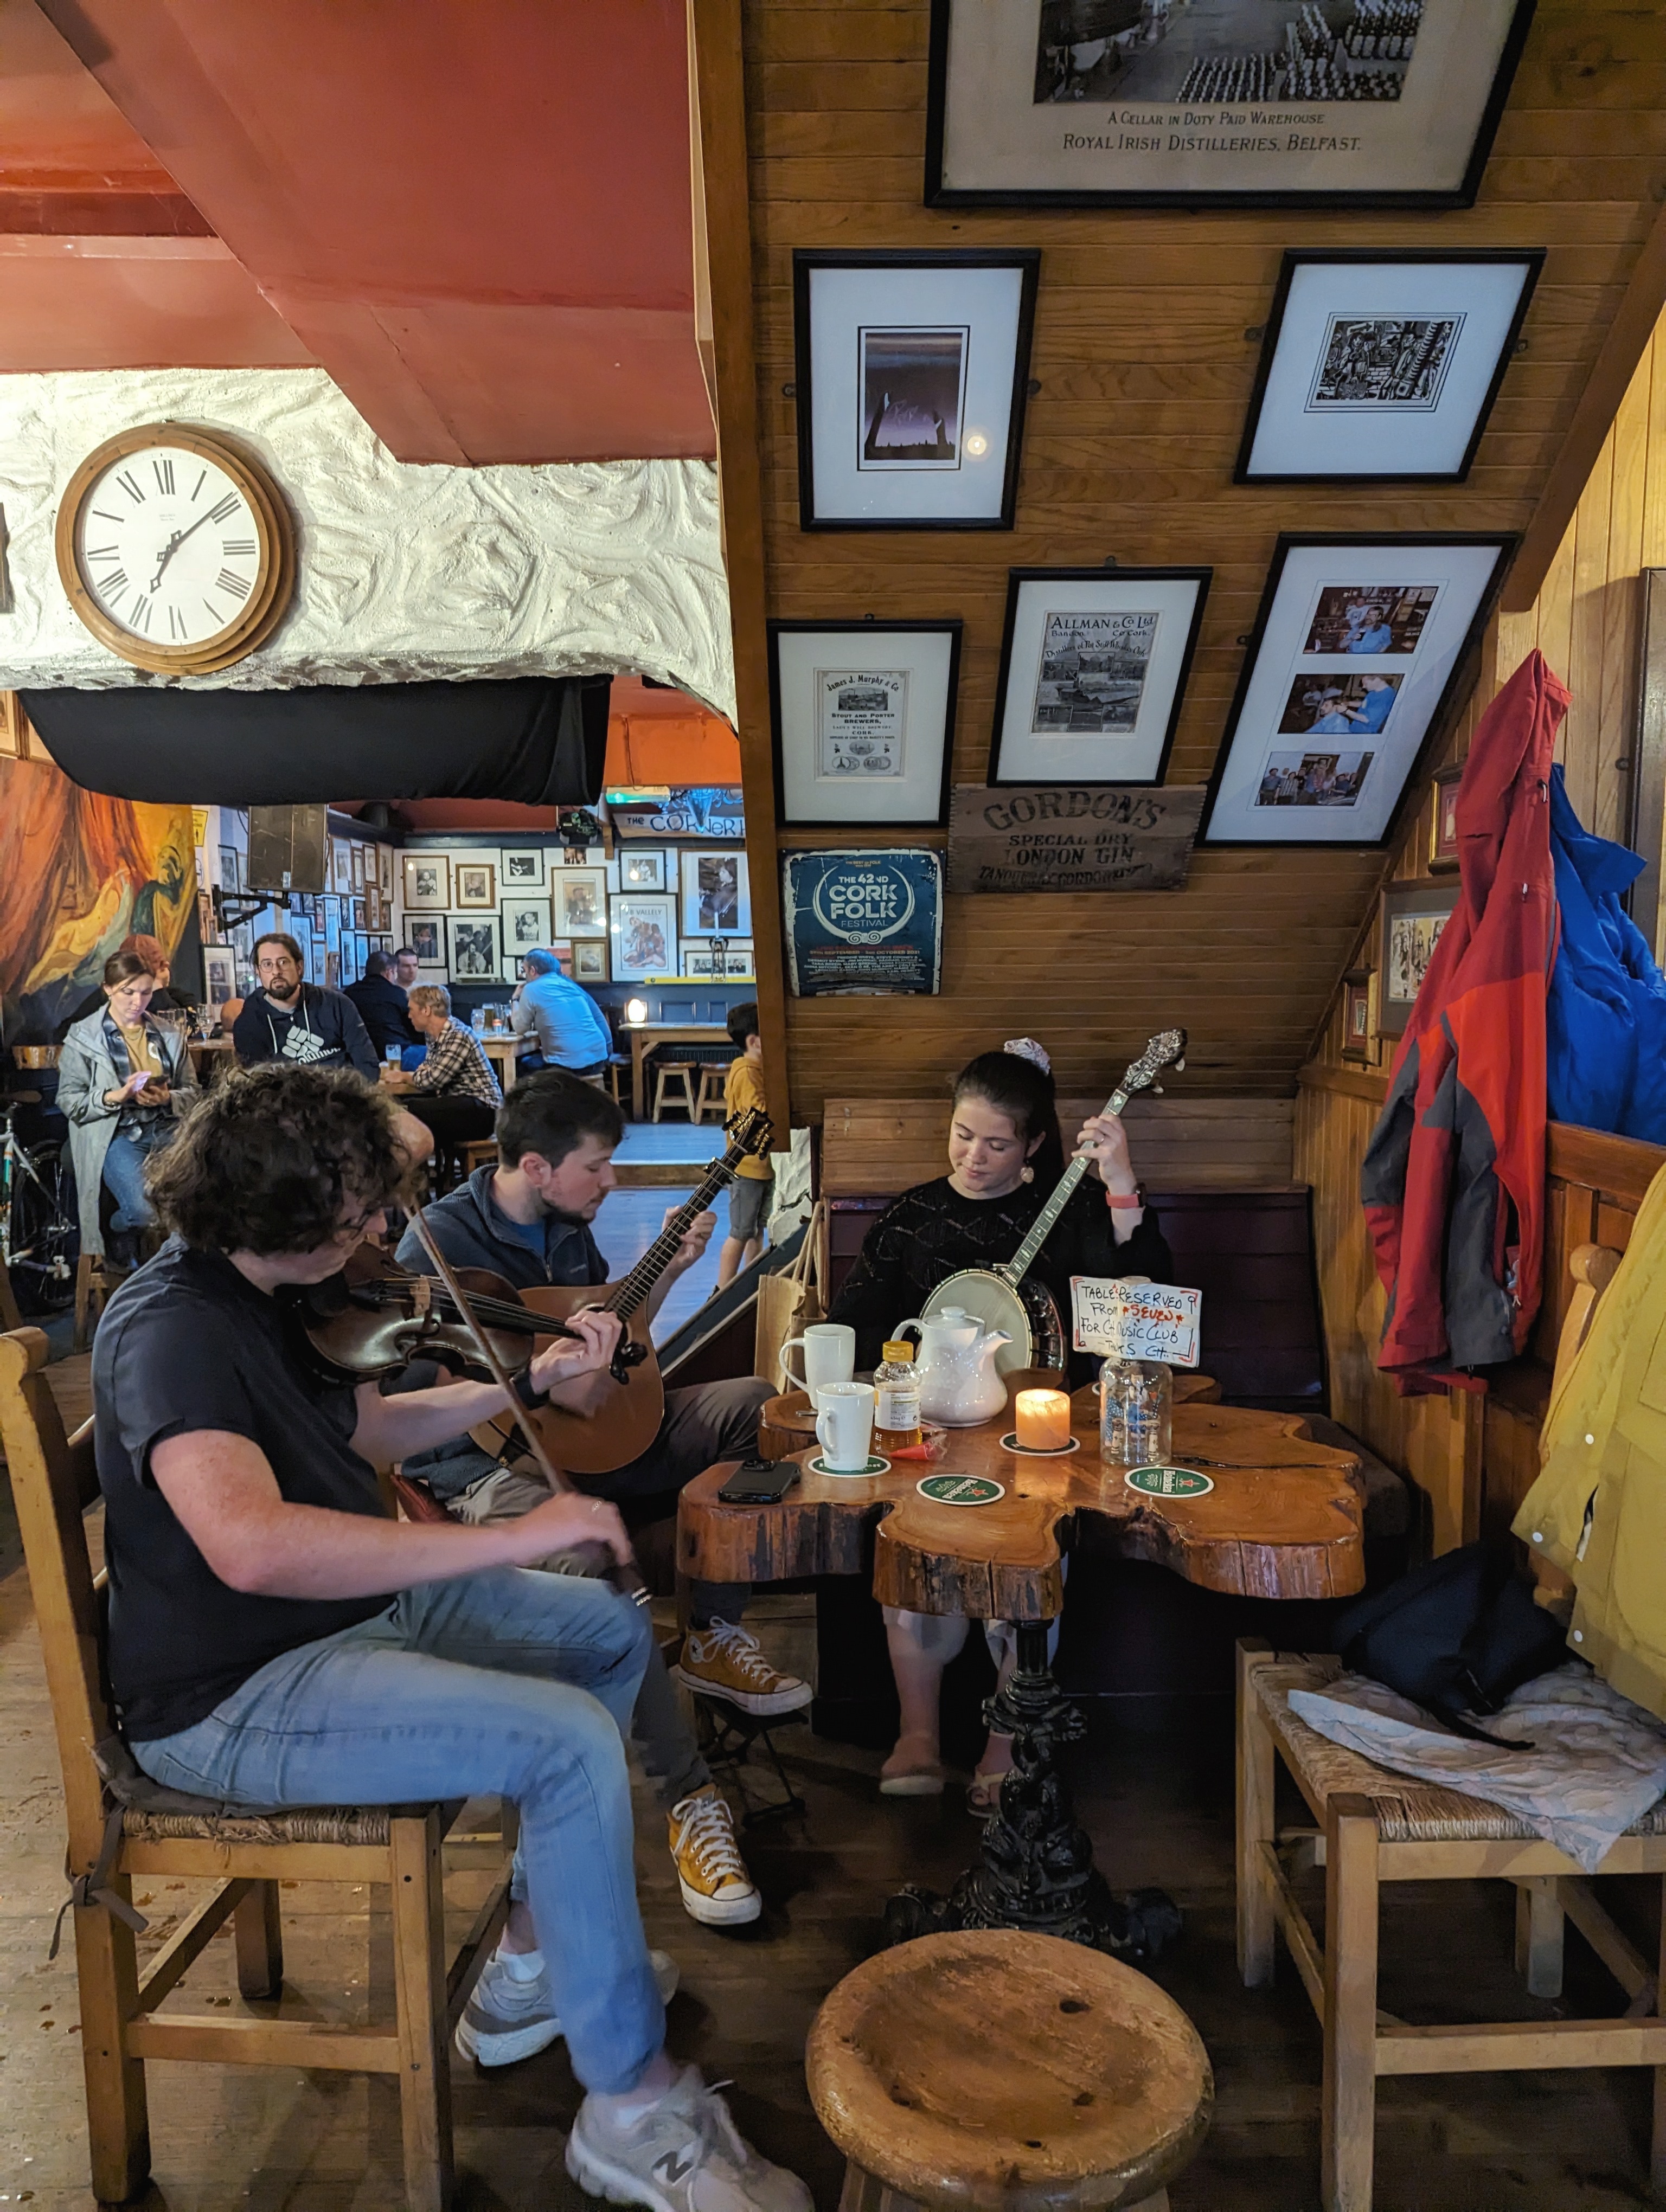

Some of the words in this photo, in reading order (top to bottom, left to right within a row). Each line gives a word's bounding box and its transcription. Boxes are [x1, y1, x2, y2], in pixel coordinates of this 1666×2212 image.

[1108, 111, 1117, 125] A
[1121, 111, 1163, 125] CELLAR
[1169, 115, 1180, 125] IN
[1219, 111, 1246, 125] PAID
[1251, 111, 1325, 124] WAREHOUSE
[1063, 133, 1113, 150] ROYAL
[1118, 133, 1161, 150] IRISH
[1050, 616, 1111, 629] ALLMAN
[826, 679, 847, 691] James
[857, 674, 884, 685] Murphy
[983, 790, 1167, 831] GORDON'S
[1009, 834, 1088, 846] SPECIAL
[1094, 833, 1135, 845] DRY
[1004, 848, 1086, 867] LONDON
[1096, 846, 1136, 864] GIN
[829, 884, 898, 902] CORK
[830, 901, 897, 919] FOLK
[841, 919, 889, 928] FESTIVAL
[1081, 1285, 1116, 1300] TABLE
[1118, 1287, 1182, 1309] RESERVED
[1090, 1302, 1118, 1316] FROM
[1080, 1317, 1101, 1334] FOR
[1146, 1324, 1179, 1343] CLUB
